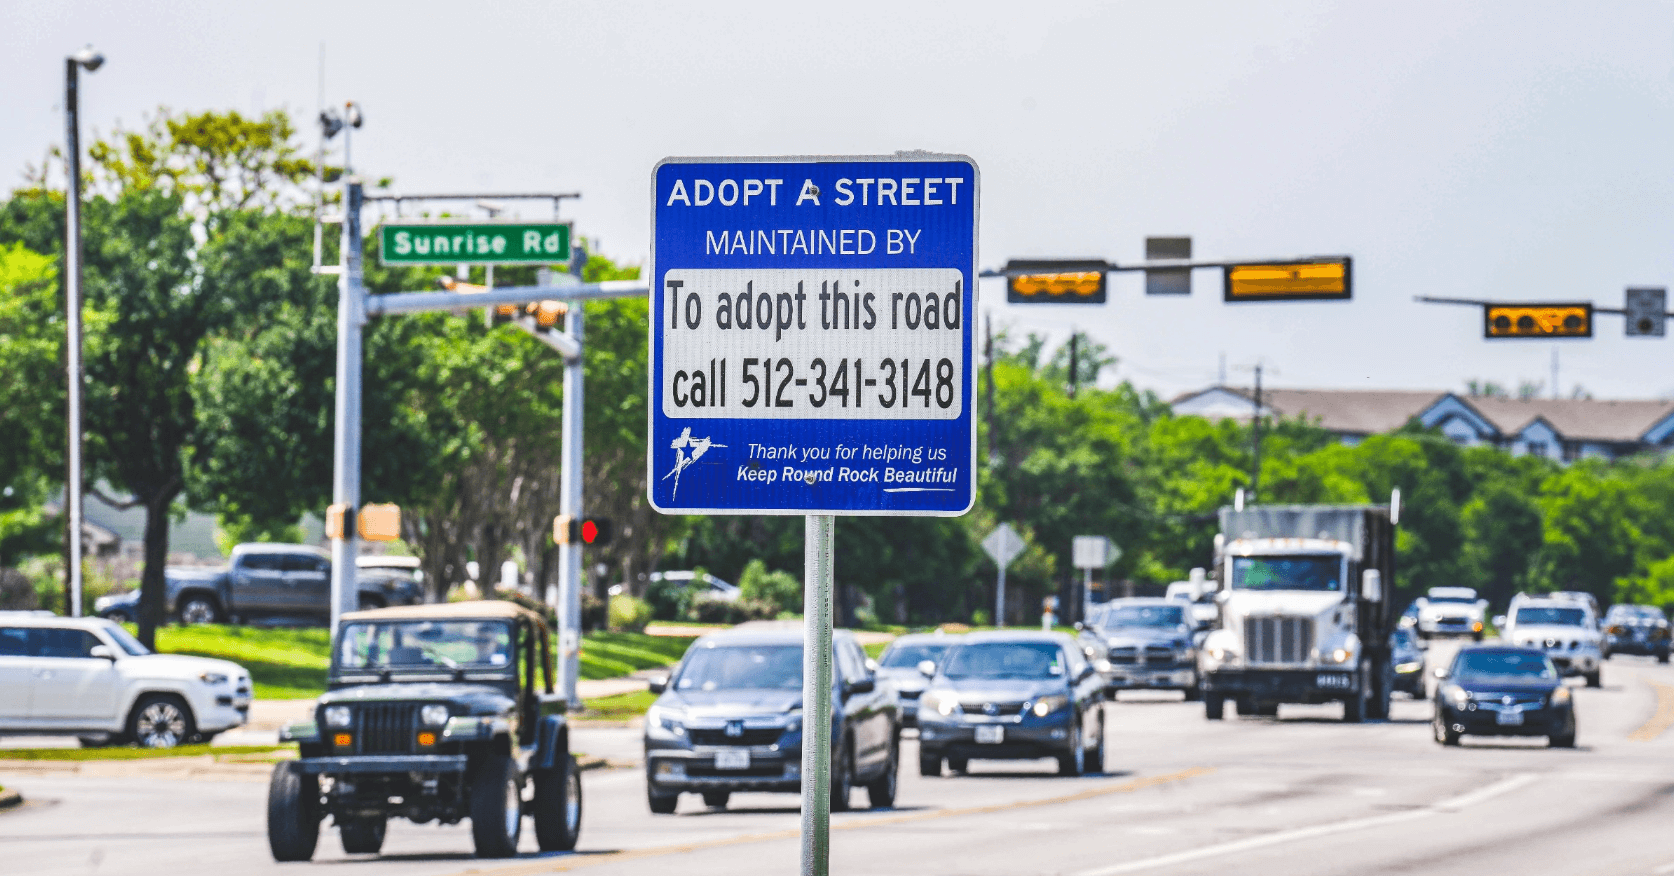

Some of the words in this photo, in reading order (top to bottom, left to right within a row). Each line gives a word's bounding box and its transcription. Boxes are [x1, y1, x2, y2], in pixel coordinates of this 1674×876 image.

[667, 178, 783, 206] ADOPT
[796, 178, 821, 206] A
[835, 177, 964, 206] STREET
[394, 230, 507, 255] Sunrise
[523, 230, 560, 254] Rd
[706, 229, 876, 255] MAINTAINED
[887, 229, 921, 255] BY
[667, 280, 702, 330] To
[716, 279, 807, 342] adopt
[819, 279, 877, 330] this
[891, 279, 960, 330] road
[672, 357, 726, 407] call
[741, 357, 954, 408] 512-341-3148
[749, 443, 797, 459] Thank
[802, 447, 831, 463] you
[835, 443, 858, 459] for
[862, 443, 922, 464] helping
[928, 447, 947, 460] us
[737, 466, 777, 483] Keep
[783, 466, 833, 482] Round
[838, 467, 879, 482] Rock
[883, 467, 957, 483] Beautiful
